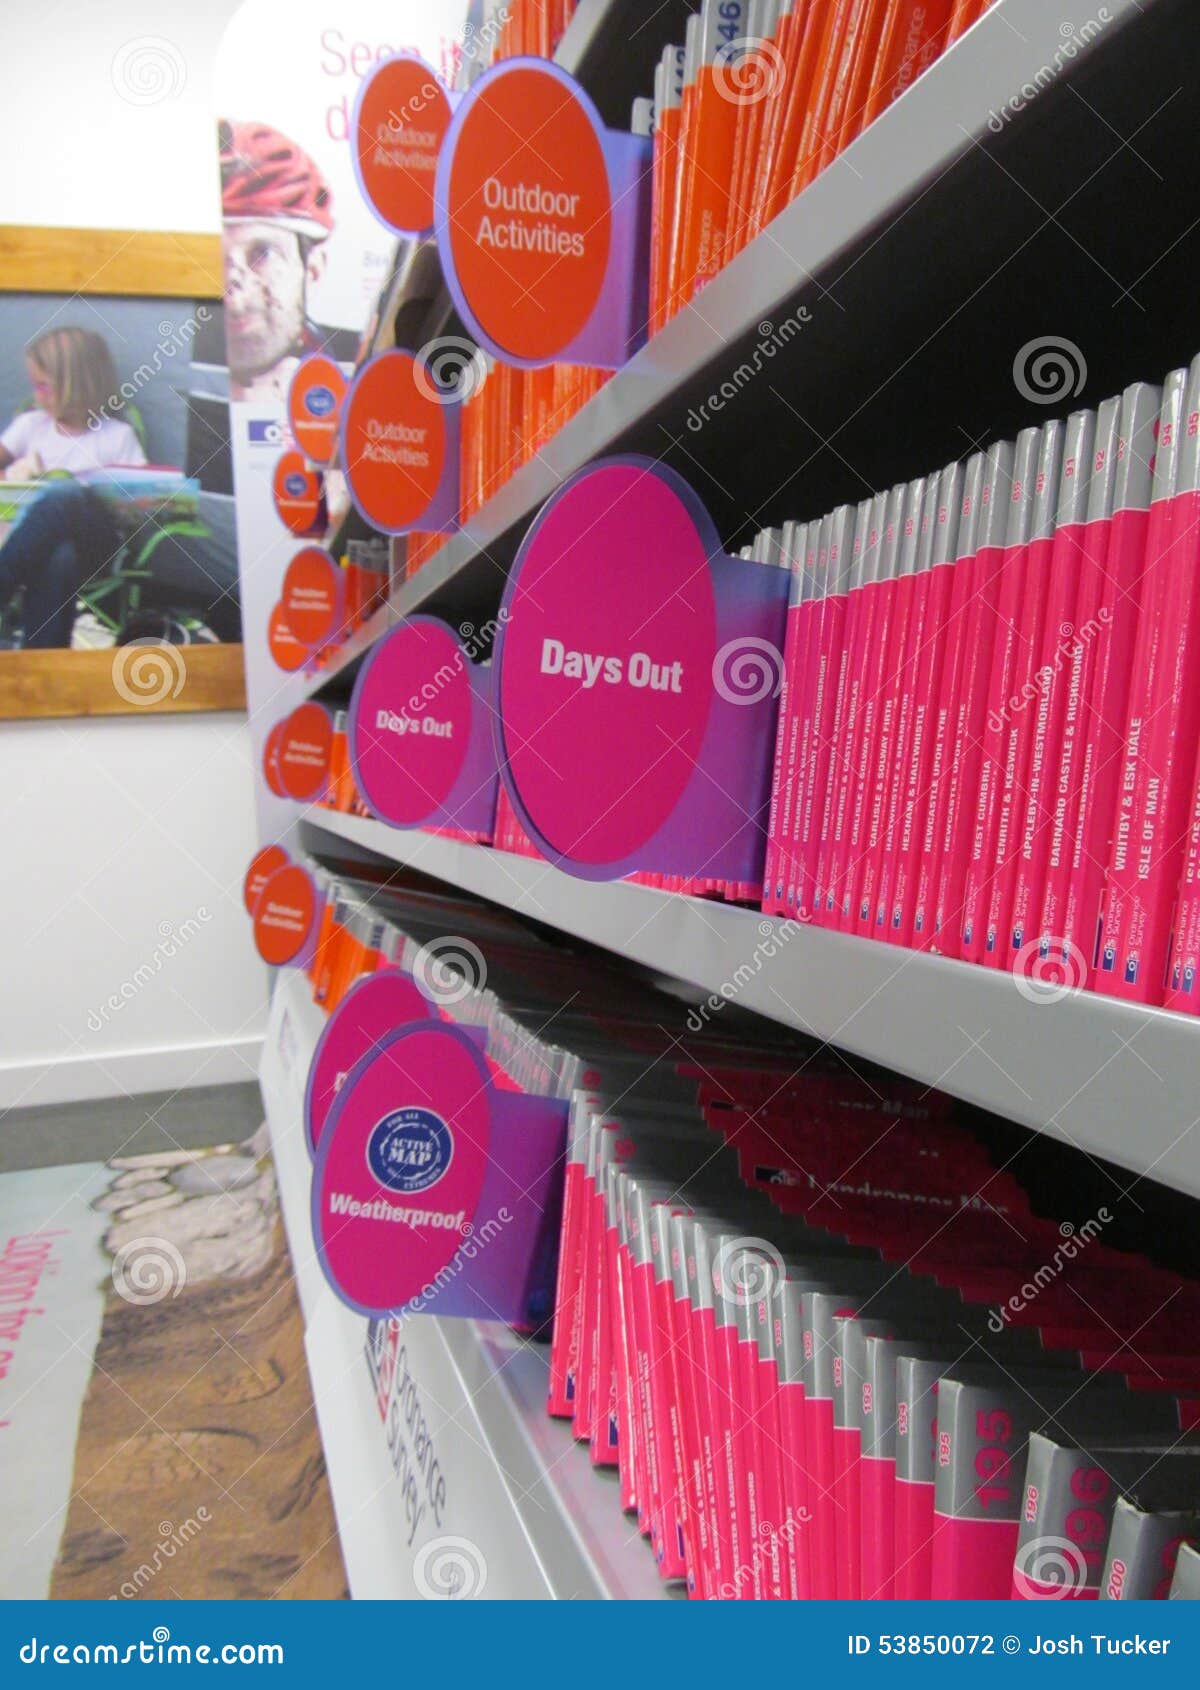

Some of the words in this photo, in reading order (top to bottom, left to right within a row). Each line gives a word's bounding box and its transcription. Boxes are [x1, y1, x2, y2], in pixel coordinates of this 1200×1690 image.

[483, 177, 580, 219] Outdoor
[476, 216, 585, 257] Activities
[366, 418, 427, 444] Outdoor
[1161, 424, 1172, 447] 94
[1187, 411, 1200, 436] 95
[362, 442, 429, 468] Activities
[1064, 457, 1075, 478] 91
[1095, 450, 1105, 472] 92
[540, 638, 623, 689] Days
[627, 652, 684, 694] Out
[1067, 645, 1084, 720] RICHMOND
[376, 709, 419, 736] Days
[422, 715, 453, 739] Out
[883, 700, 892, 732] FIRTH
[937, 708, 948, 740] TYNE
[1065, 725, 1075, 736] &
[909, 705, 925, 784] HALTWHISTLE
[1127, 718, 1142, 756] DALE
[851, 794, 863, 844] CARLISLE
[865, 702, 874, 733] FIRTH
[877, 736, 889, 778] SOLWAY
[933, 744, 944, 776] UPON
[1004, 728, 1019, 788] KESWICK
[1023, 666, 1053, 859] APPLEBY-IN-WESTMORLAND
[1058, 740, 1073, 793] CASTLE
[835, 786, 847, 841] DUMFRIES
[843, 732, 853, 772] CASTLE
[876, 782, 883, 790] &
[908, 788, 915, 797] &
[977, 761, 992, 820] CUMBRIA
[1123, 761, 1137, 790] ESK
[944, 778, 957, 852] NEWCASTLE
[952, 740, 962, 773] UPON
[1003, 793, 1012, 803] &
[1122, 796, 1133, 807] &
[1145, 778, 1159, 814] MAN
[869, 794, 882, 847] CARLISLE
[902, 801, 914, 851] HEXHAM
[924, 780, 939, 852] NEWCASTLE
[1050, 798, 1066, 867] BARNARD
[1142, 820, 1154, 840] OF
[973, 824, 984, 860] WEST
[996, 808, 1010, 864] PENRITH
[1114, 812, 1131, 870] WHITBY
[1137, 846, 1152, 879] ISLE
[388, 1147, 432, 1166] MAP
[390, 1137, 434, 1152] ACTIVE
[329, 1192, 466, 1231] Weatherproof
[834, 1357, 842, 1386] 192
[862, 1383, 872, 1414] 193
[899, 1402, 908, 1434] 194
[939, 1431, 951, 1466] 195
[974, 1407, 1014, 1511] 195
[388, 1399, 426, 1548] Survey
[1024, 1485, 1038, 1522] 196
[1108, 1560, 1125, 1600] 200
